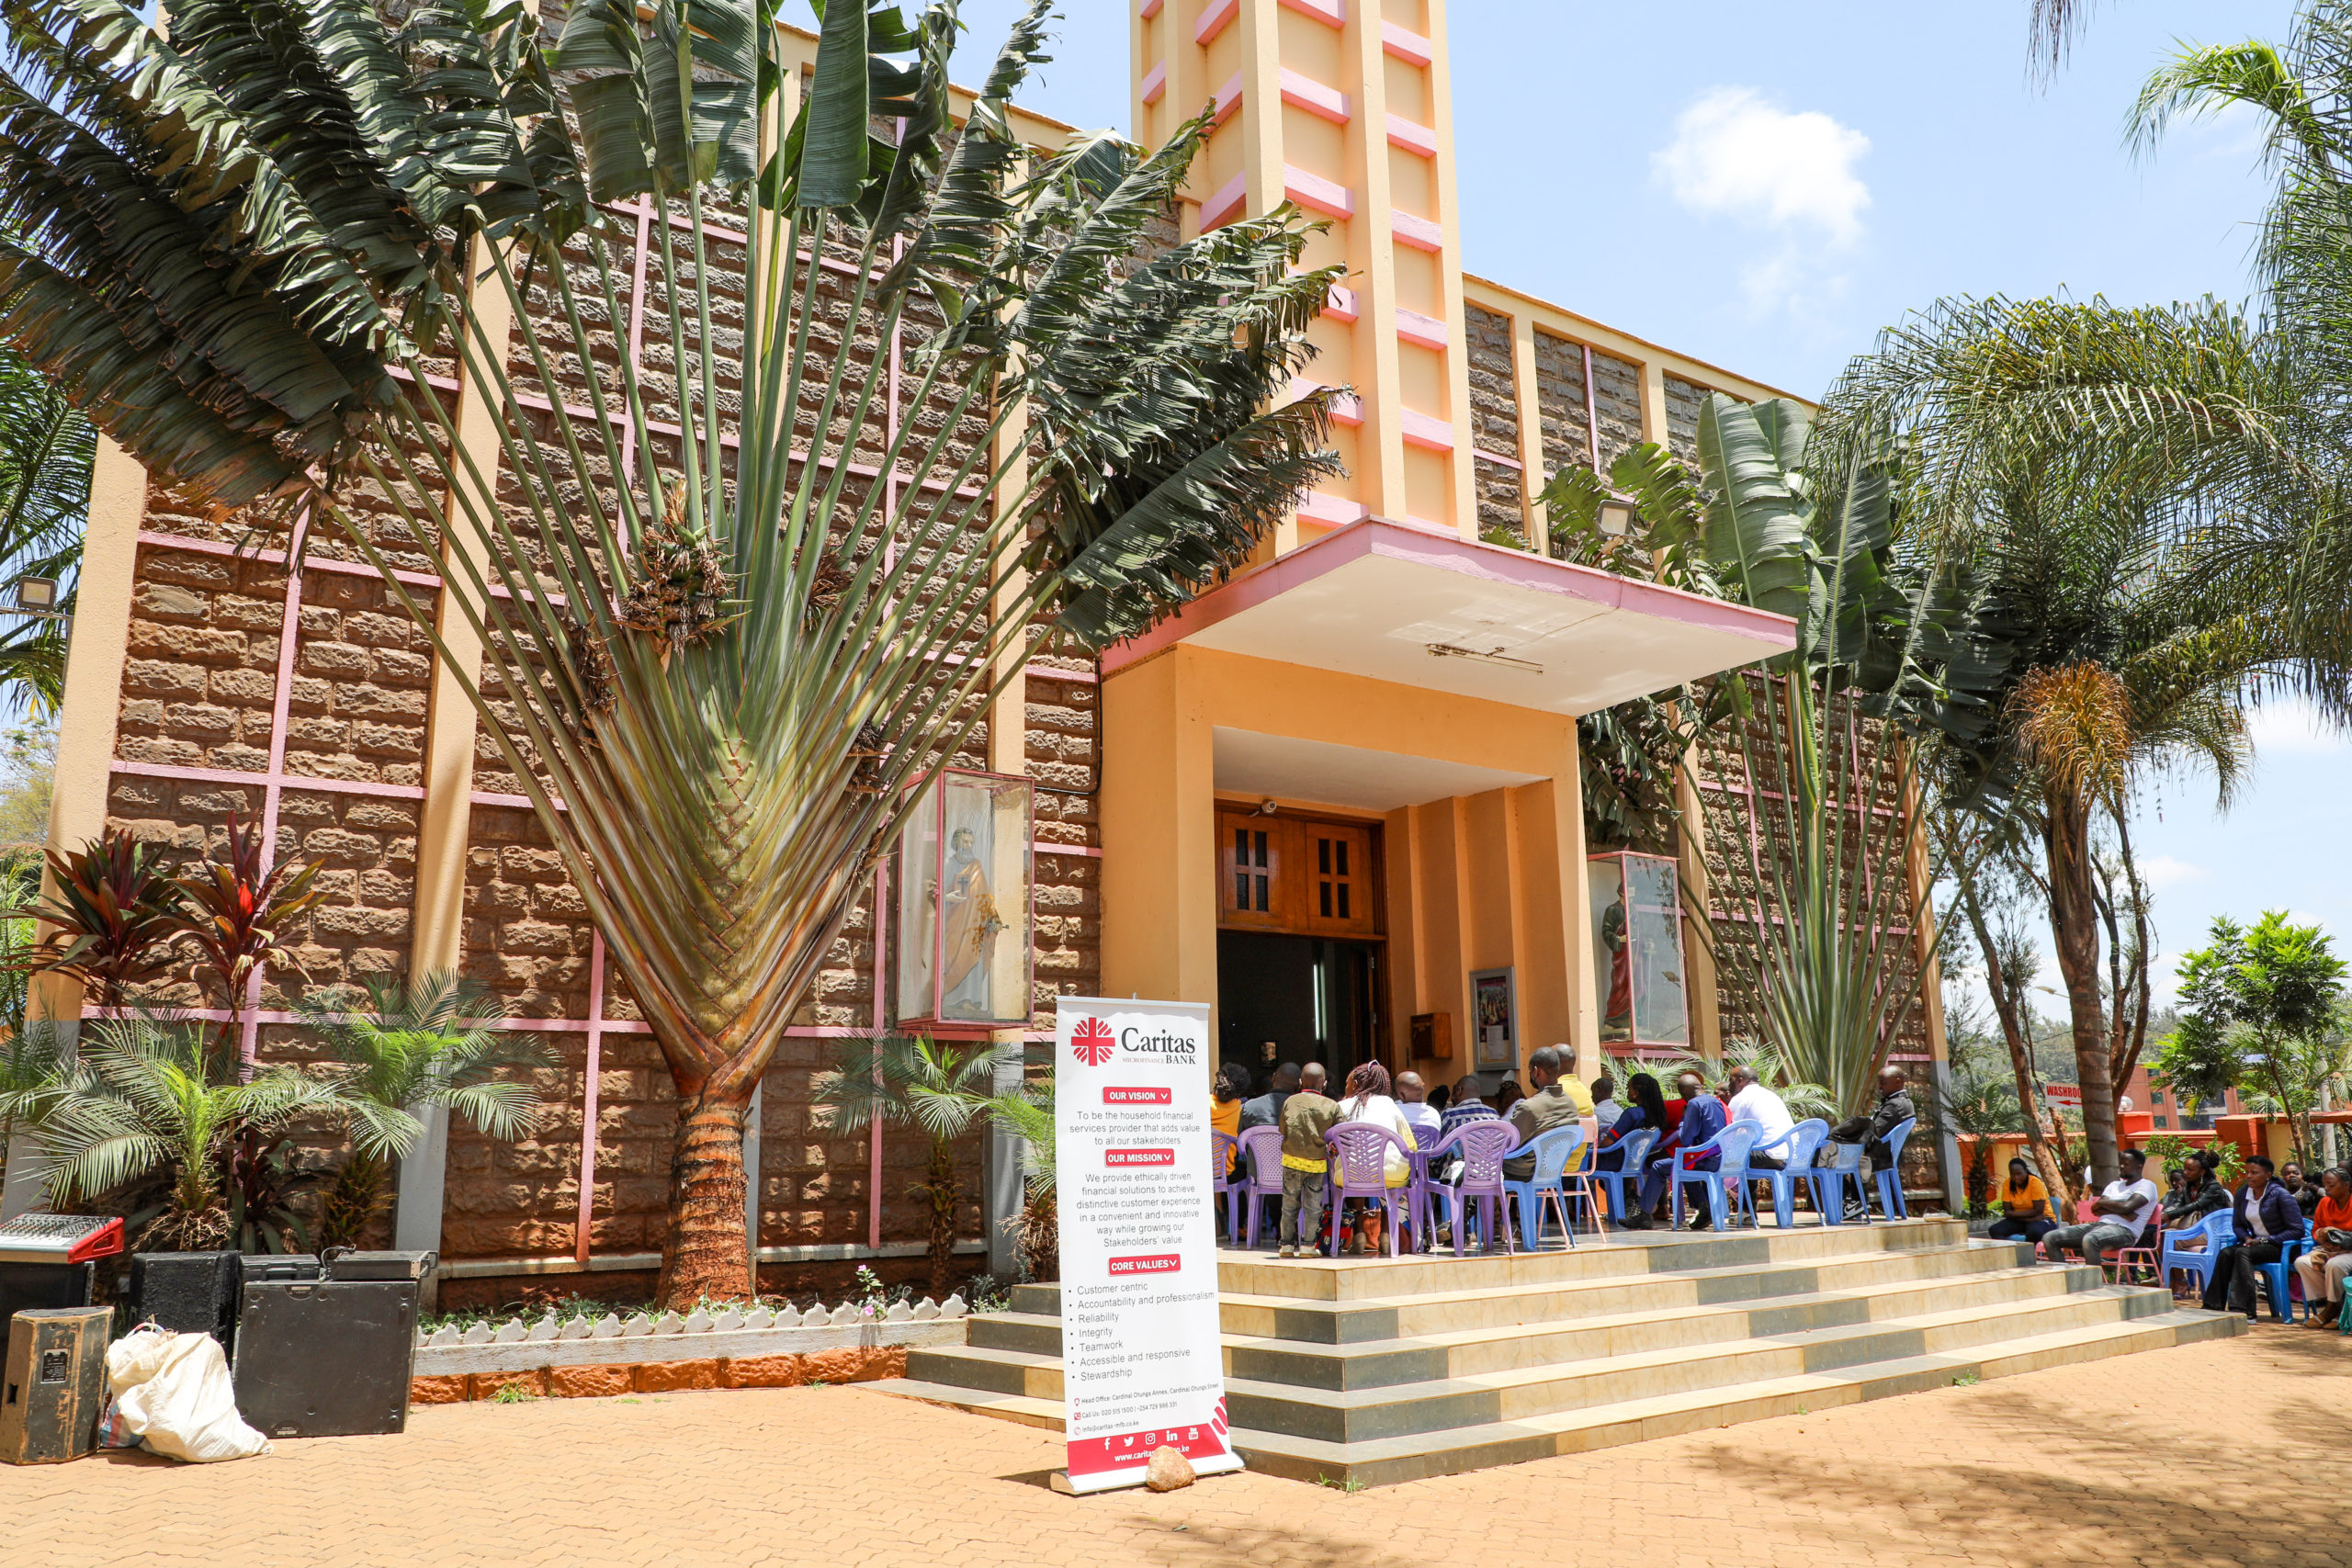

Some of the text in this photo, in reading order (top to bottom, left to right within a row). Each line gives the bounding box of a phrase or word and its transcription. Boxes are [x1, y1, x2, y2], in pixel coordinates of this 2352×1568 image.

[1121, 1027, 1195, 1054] Caritas
[1166, 1055, 1196, 1065] BANK
[1109, 1091, 1156, 1100] OUR VISION
[2046, 1085, 2082, 1099] WASHROO
[1077, 1111, 1193, 1120] To be the household financial
[1069, 1124, 1106, 1133] services
[1109, 1124, 1141, 1134] provider
[1094, 1137, 1102, 1145] to
[1105, 1136, 1114, 1145] all
[1132, 1136, 1182, 1145] stakeholders
[1108, 1154, 1163, 1163] OUR MISSION
[1085, 1172, 1192, 1184] We provide ethically driven
[1081, 1187, 1117, 1196] financial
[1119, 1185, 1156, 1195] solutions
[1168, 1185, 1195, 1193] achieve
[1076, 1197, 1201, 1209] distinctive customer experience
[1080, 1213, 1088, 1222] in
[1099, 1212, 1142, 1222] convenient
[1145, 1211, 1160, 1220] and
[1163, 1210, 1200, 1219] innovative
[1097, 1227, 1113, 1235] way
[1115, 1224, 1136, 1234] while
[1139, 1224, 1171, 1235] growing
[1161, 1235, 1182, 1244] value
[1111, 1259, 1169, 1270] CORE VALUES
[1077, 1281, 1148, 1295] Customer centric
[1078, 1291, 1215, 1309] Accountability and professionalism
[1079, 1313, 1119, 1323] Reliability
[1079, 1327, 1113, 1339] Integrity
[1080, 1340, 1123, 1352] Teamwork
[1080, 1348, 1191, 1366] Accessible and responsive
[1080, 1368, 1132, 1381] Stewardship
